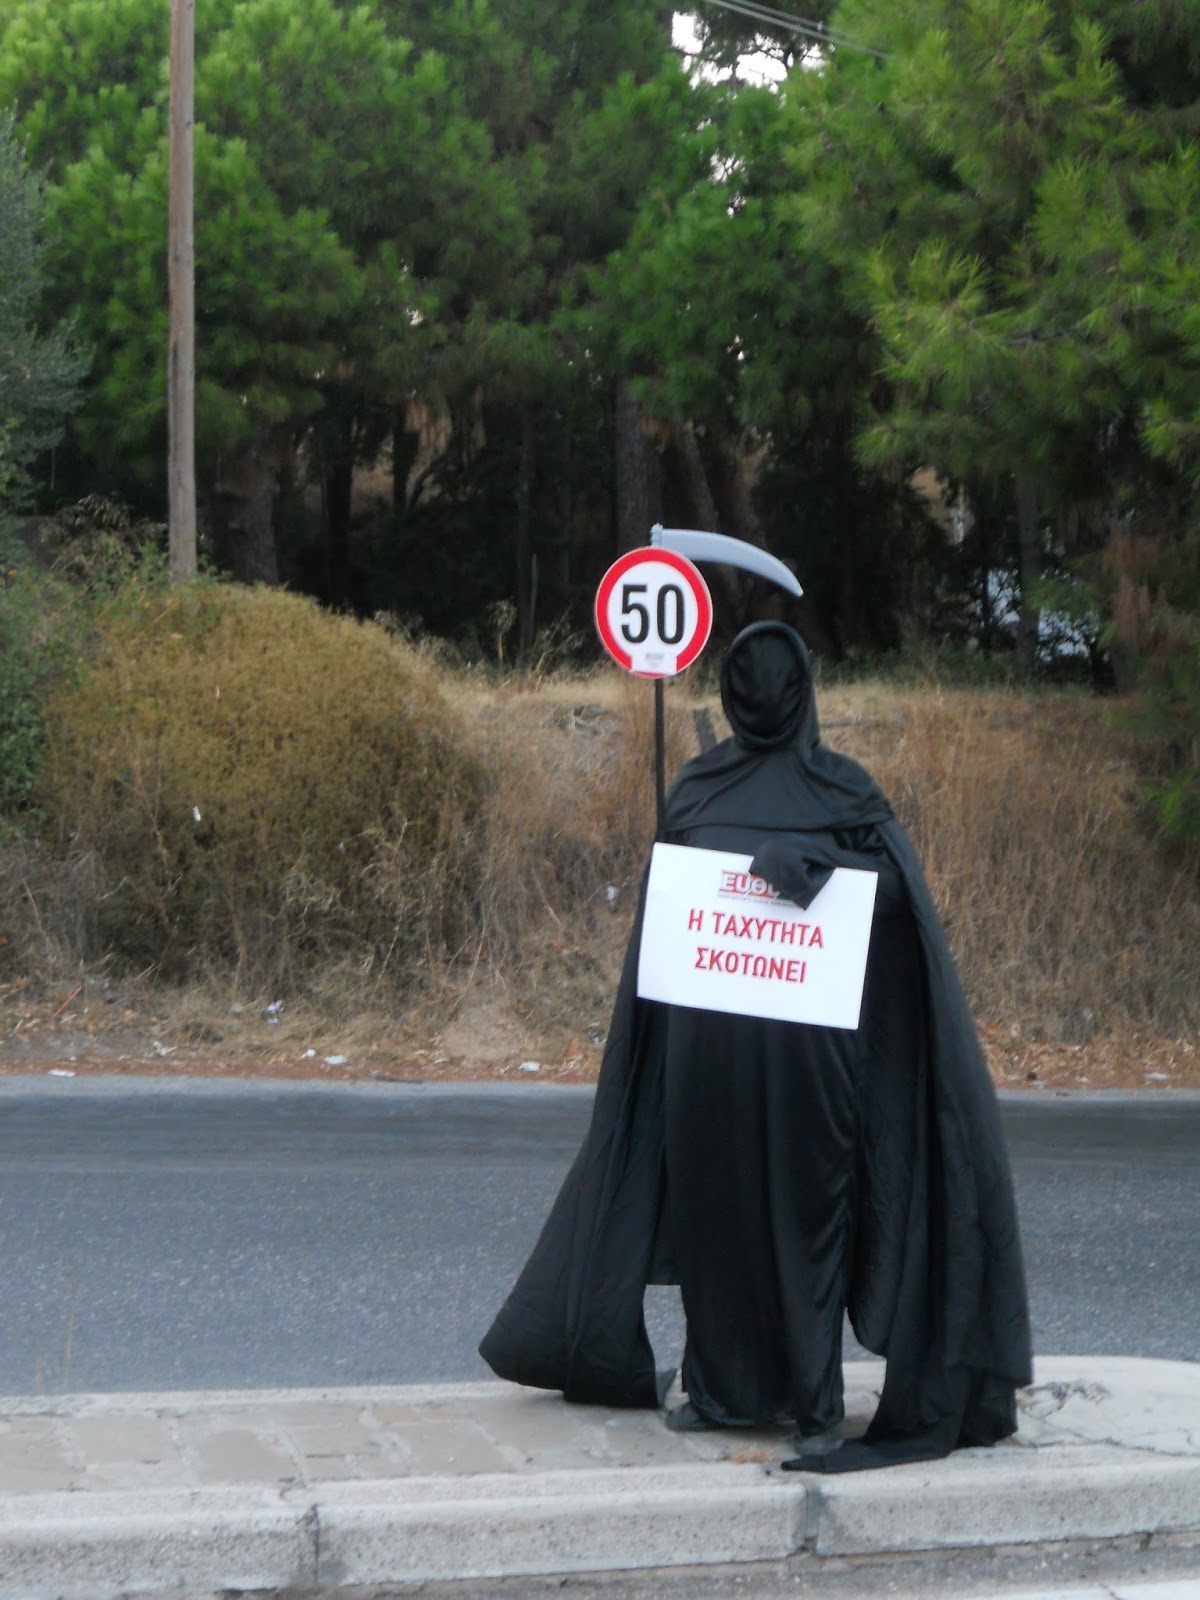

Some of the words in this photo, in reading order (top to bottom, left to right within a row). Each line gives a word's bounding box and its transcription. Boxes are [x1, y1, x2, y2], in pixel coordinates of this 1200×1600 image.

[621, 584, 685, 644] 50
[687, 908, 704, 931] Η
[712, 912, 824, 949] ΤΑΧΥΤΗΤΑ
[694, 947, 808, 984] ΣΚΟΤΩΝΕΙ
